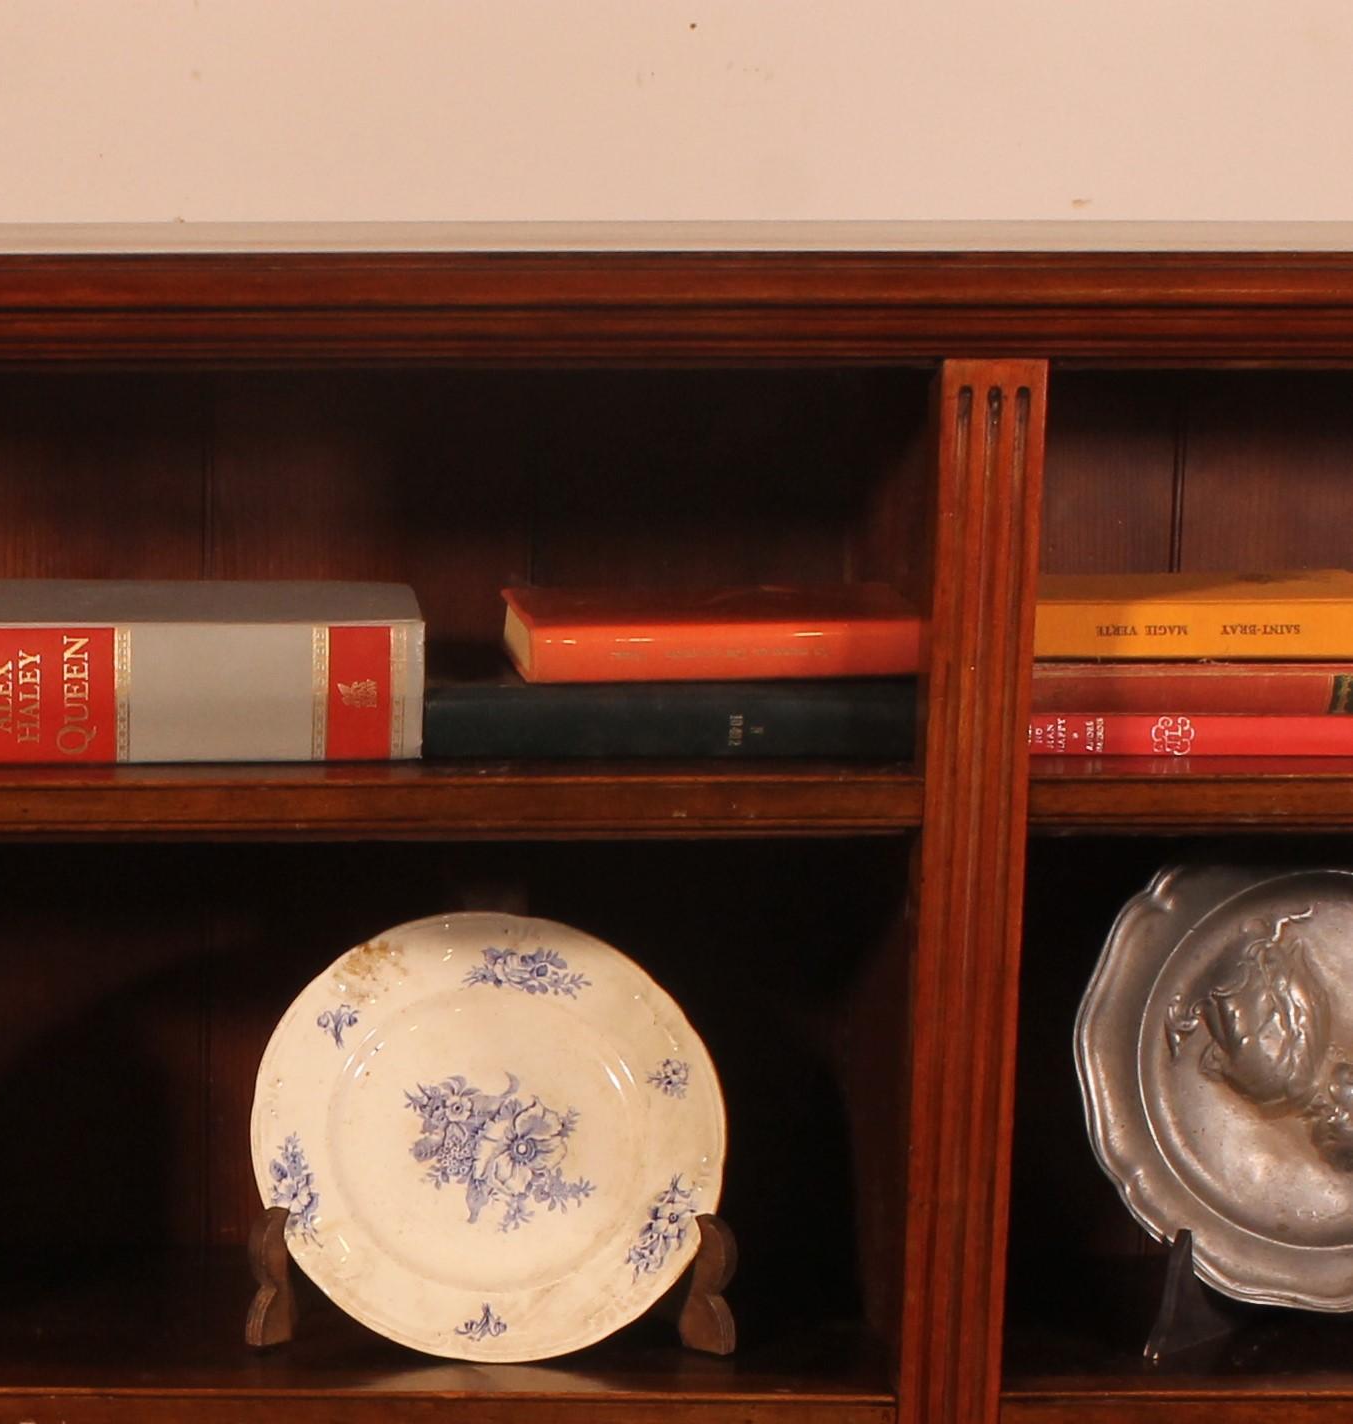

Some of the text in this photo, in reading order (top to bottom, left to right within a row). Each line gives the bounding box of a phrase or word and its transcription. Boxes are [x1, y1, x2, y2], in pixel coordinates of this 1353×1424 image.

[1096, 625, 1188, 636] MAGIE VERTE
[1221, 625, 1301, 636] SAINT-BRAY
[17, 650, 40, 743] HALEY
[56, 635, 96, 754] QUEEN
